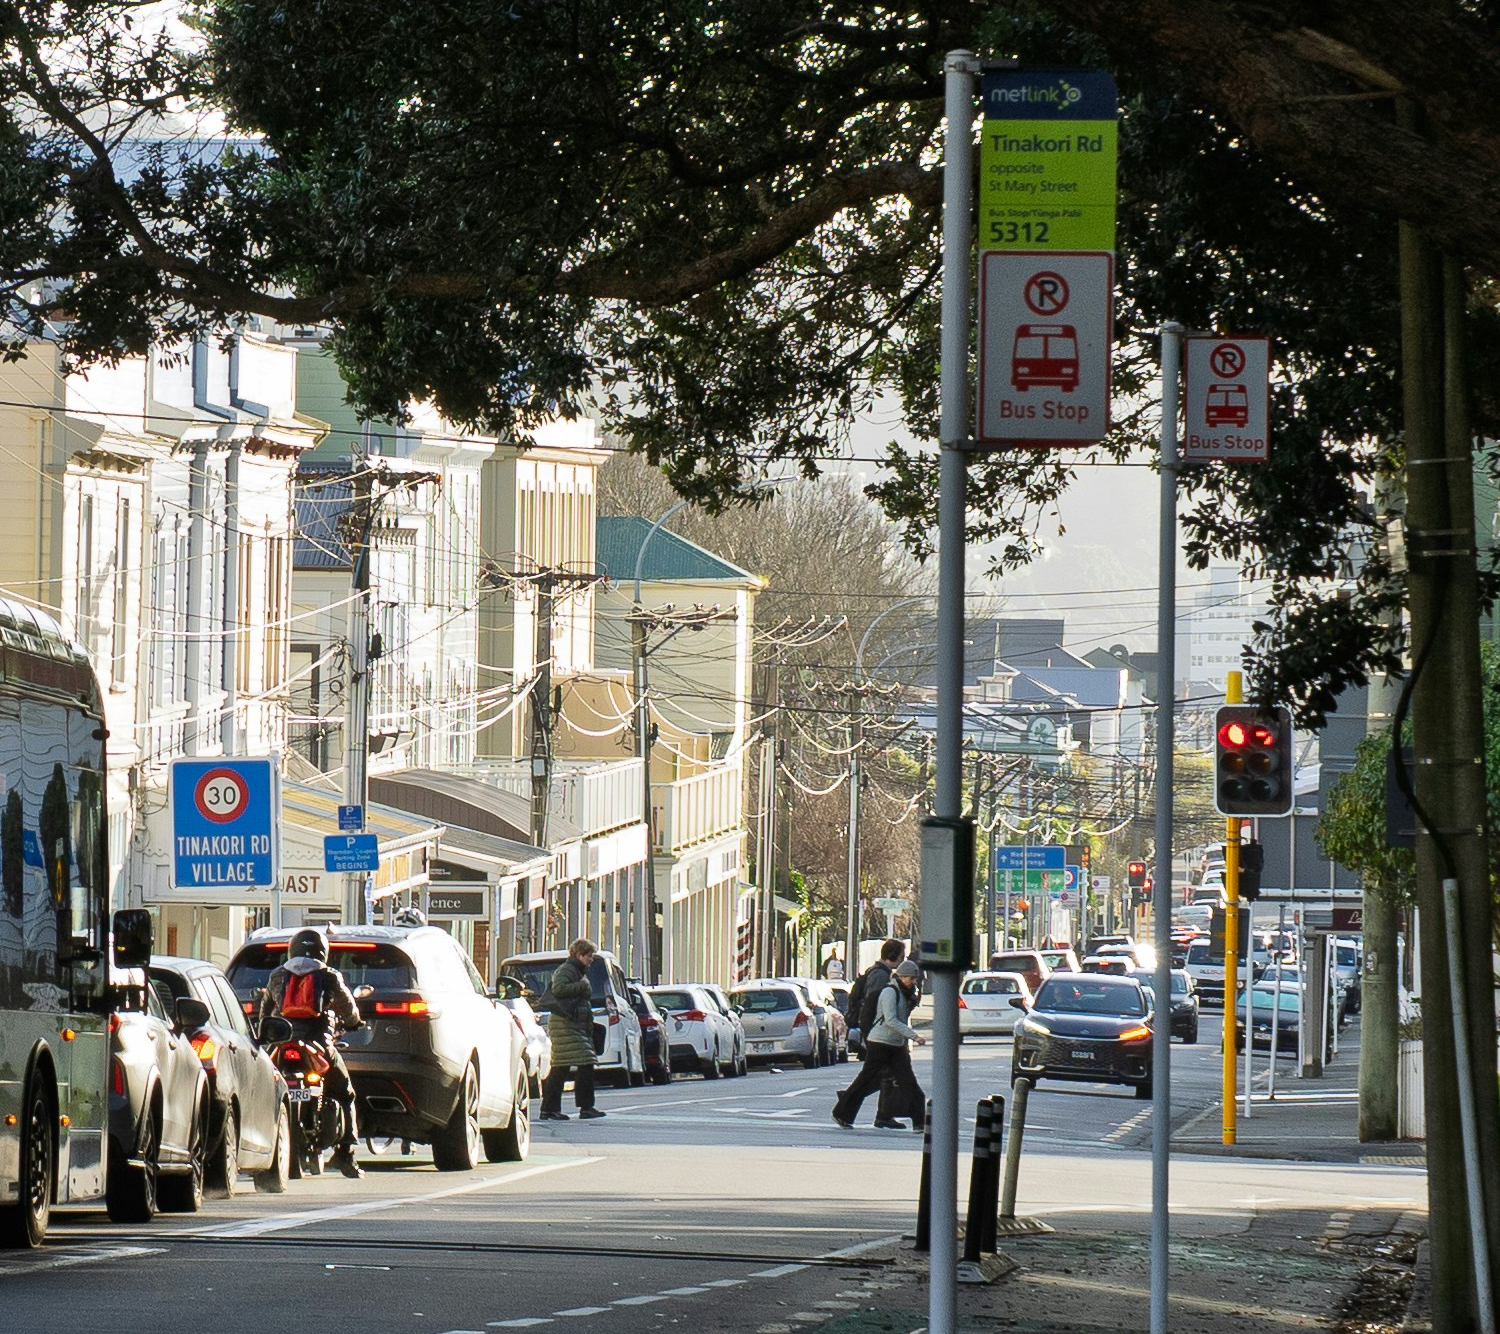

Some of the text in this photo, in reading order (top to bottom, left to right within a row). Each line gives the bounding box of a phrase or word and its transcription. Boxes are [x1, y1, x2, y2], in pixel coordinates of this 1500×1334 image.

[991, 85, 1059, 102] metlink
[989, 134, 1103, 153] Tinakori Rd
[989, 162, 1044, 177] opposite
[989, 180, 1078, 195] St Mary Street
[990, 220, 1049, 244] 5312
[1000, 400, 1090, 423] Bus Stop
[1189, 434, 1265, 453] Bus Stop
[208, 786, 236, 805] 30
[346, 807, 354, 816] P
[177, 834, 270, 856] TINAKORI RD
[346, 836, 356, 849] P
[191, 862, 255, 882] VILLAGE
[335, 861, 369, 870] BEGINS
